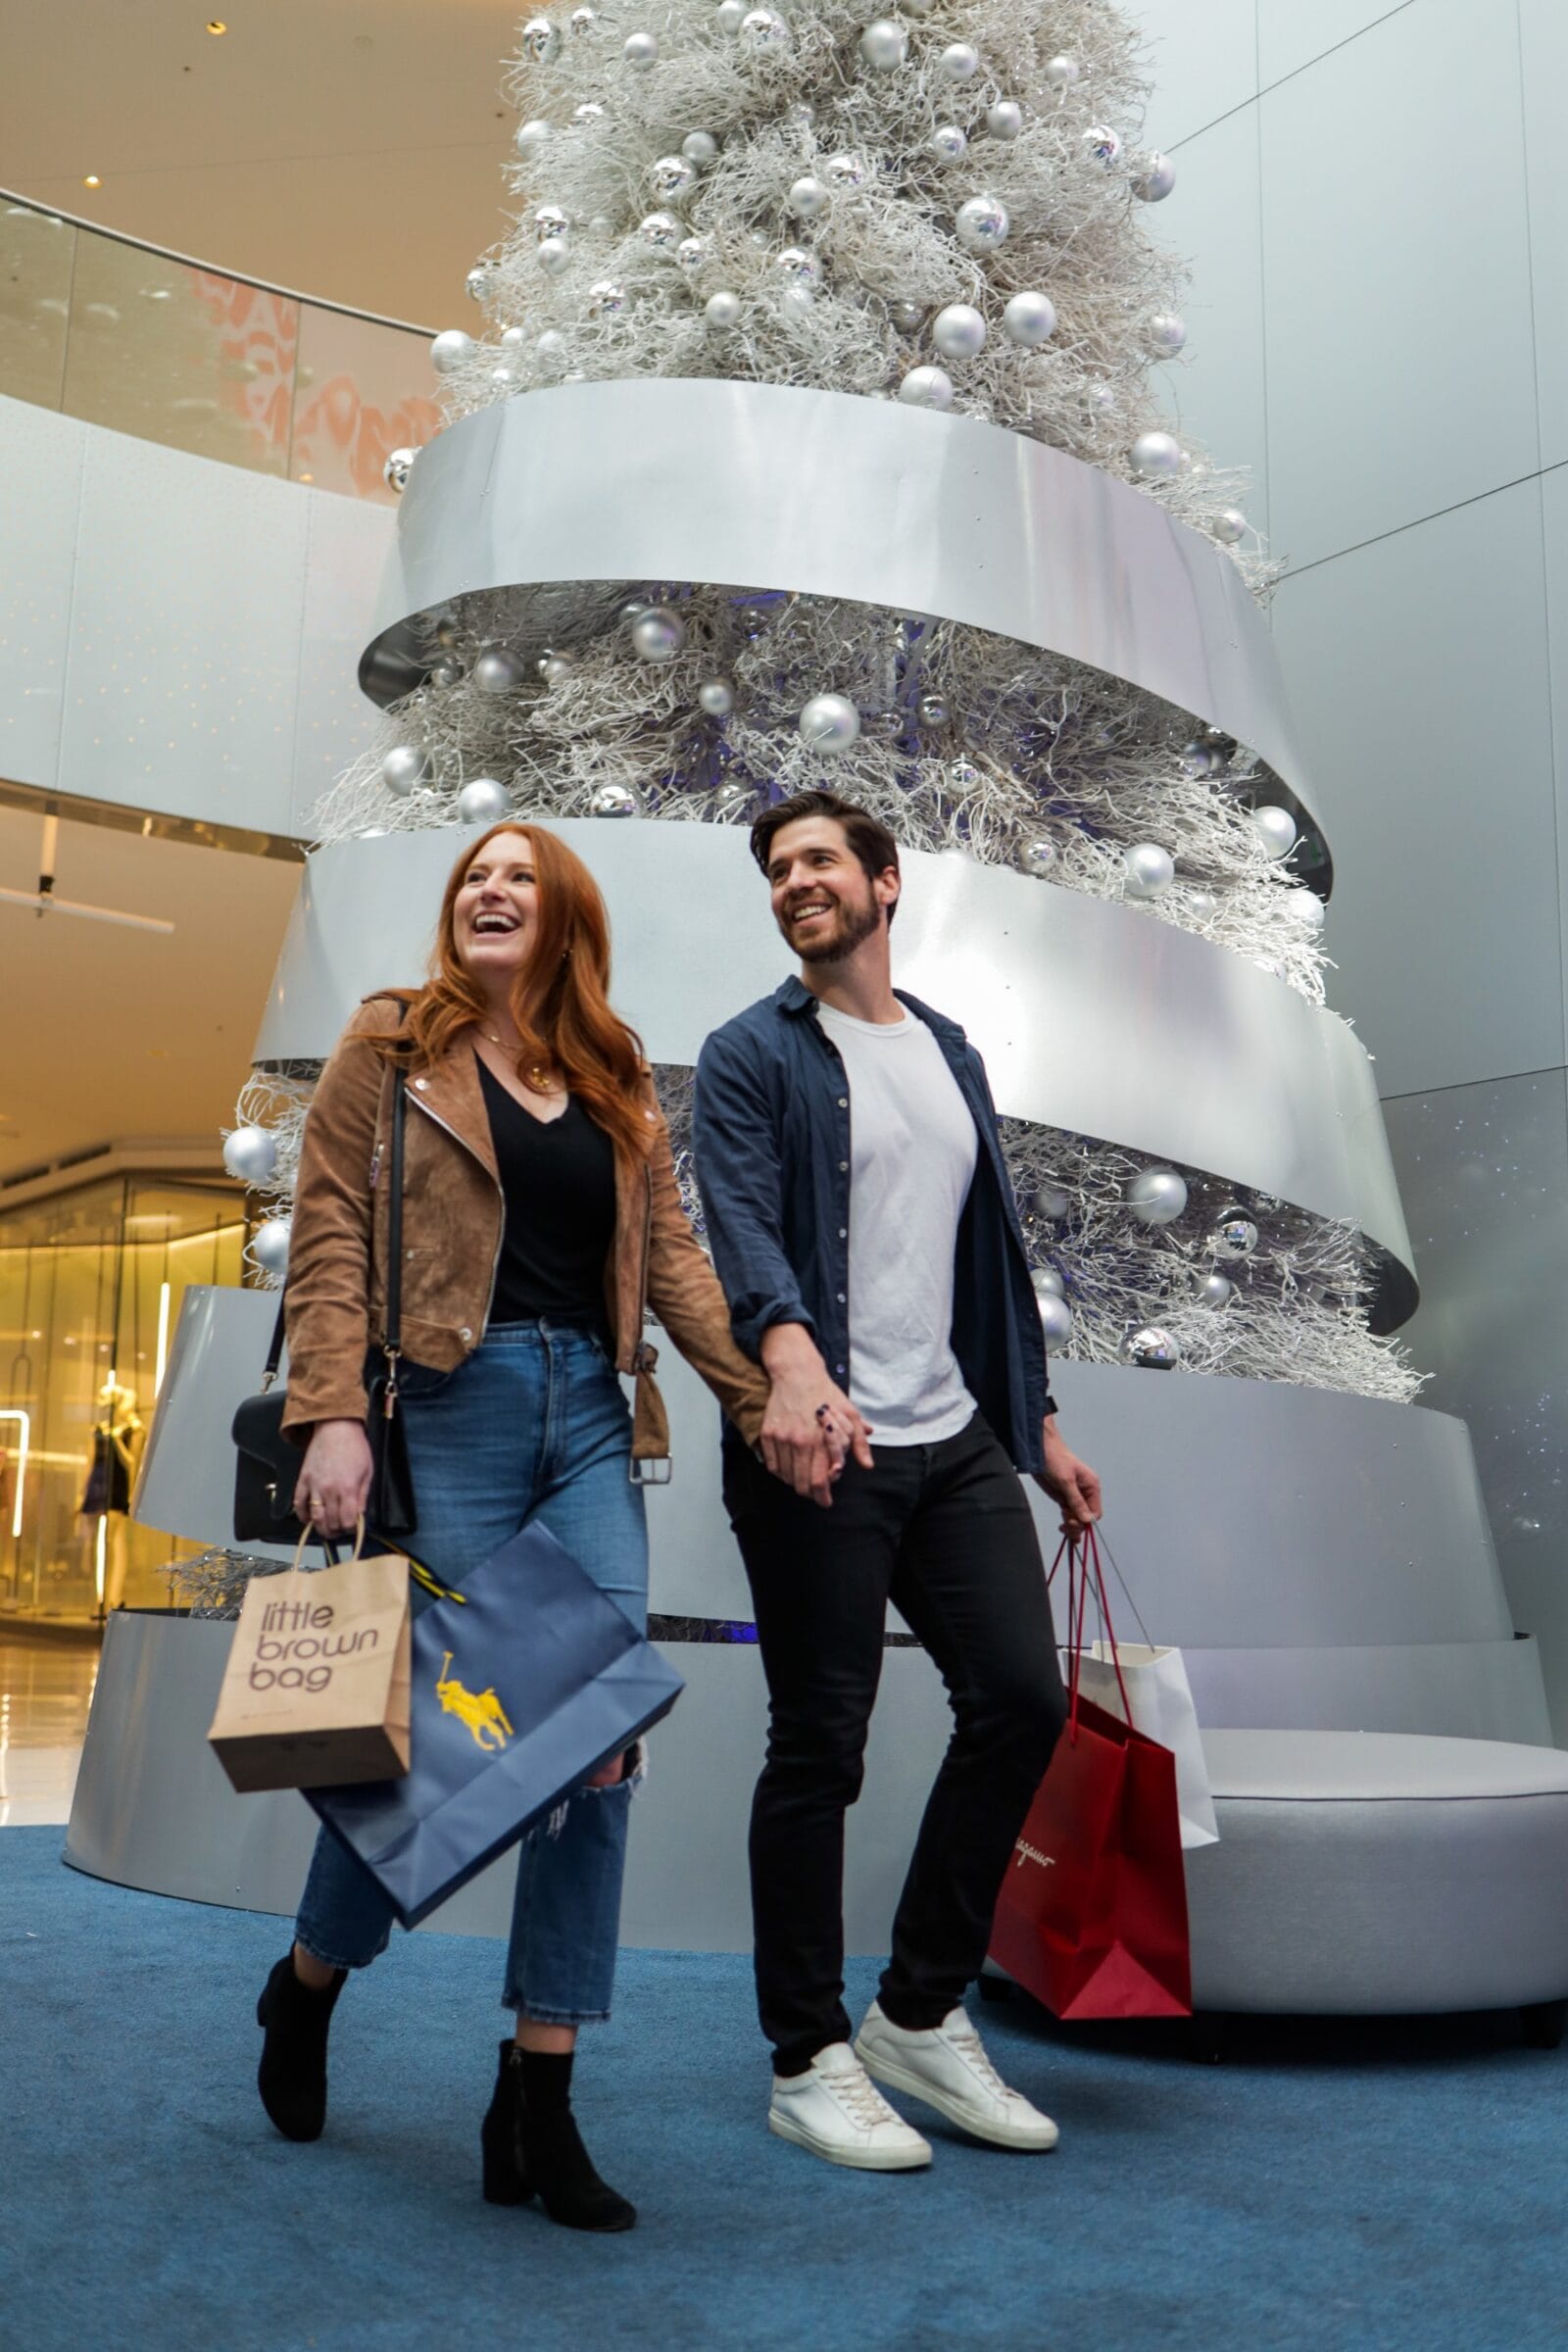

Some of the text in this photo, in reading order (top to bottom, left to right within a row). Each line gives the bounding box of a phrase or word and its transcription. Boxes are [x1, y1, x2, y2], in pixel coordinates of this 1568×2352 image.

[260, 1600, 335, 1632] little
[256, 1629, 379, 1661] brown
[248, 1662, 333, 1693] bag
